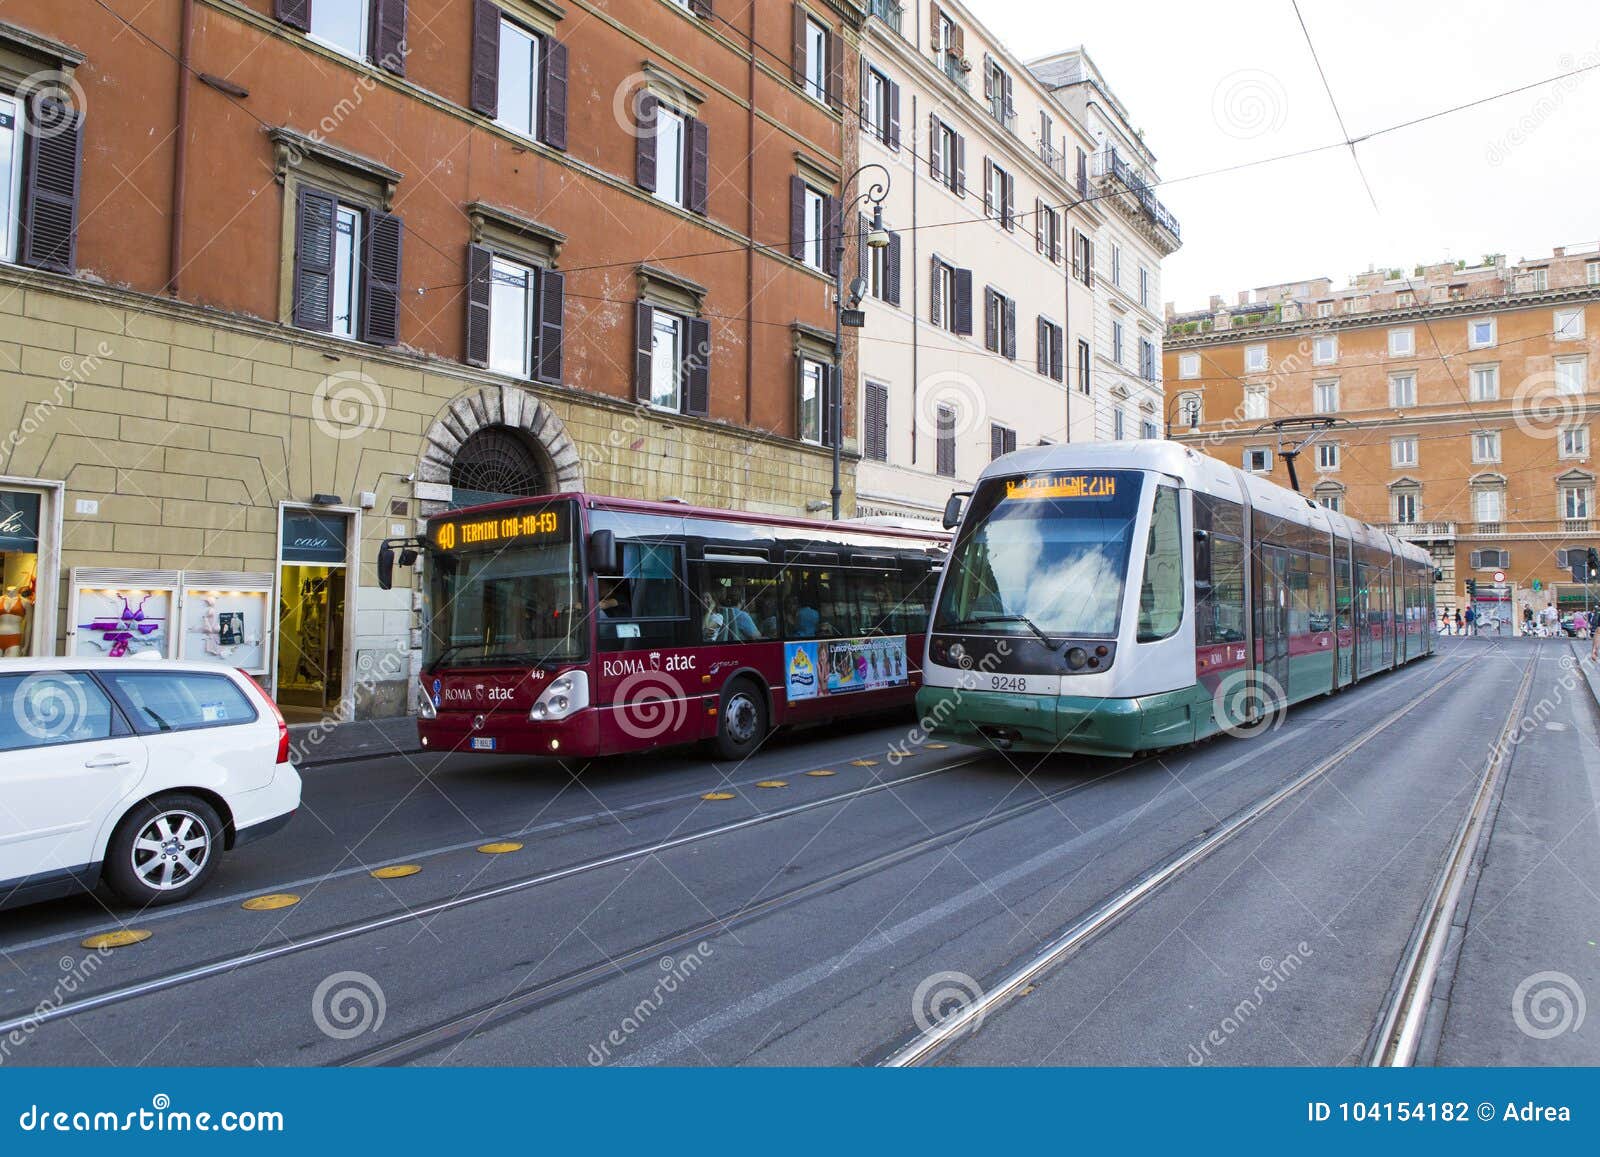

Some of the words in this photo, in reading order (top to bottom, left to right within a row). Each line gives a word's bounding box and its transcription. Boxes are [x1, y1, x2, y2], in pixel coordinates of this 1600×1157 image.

[438, 523, 455, 550] 40
[461, 521, 499, 543] TERMINI
[603, 658, 646, 677] ROMA
[665, 653, 697, 671] atac
[531, 669, 545, 680] 443
[991, 676, 1026, 691] 9248
[445, 688, 473, 700] ROMA
[488, 686, 515, 700] atac
